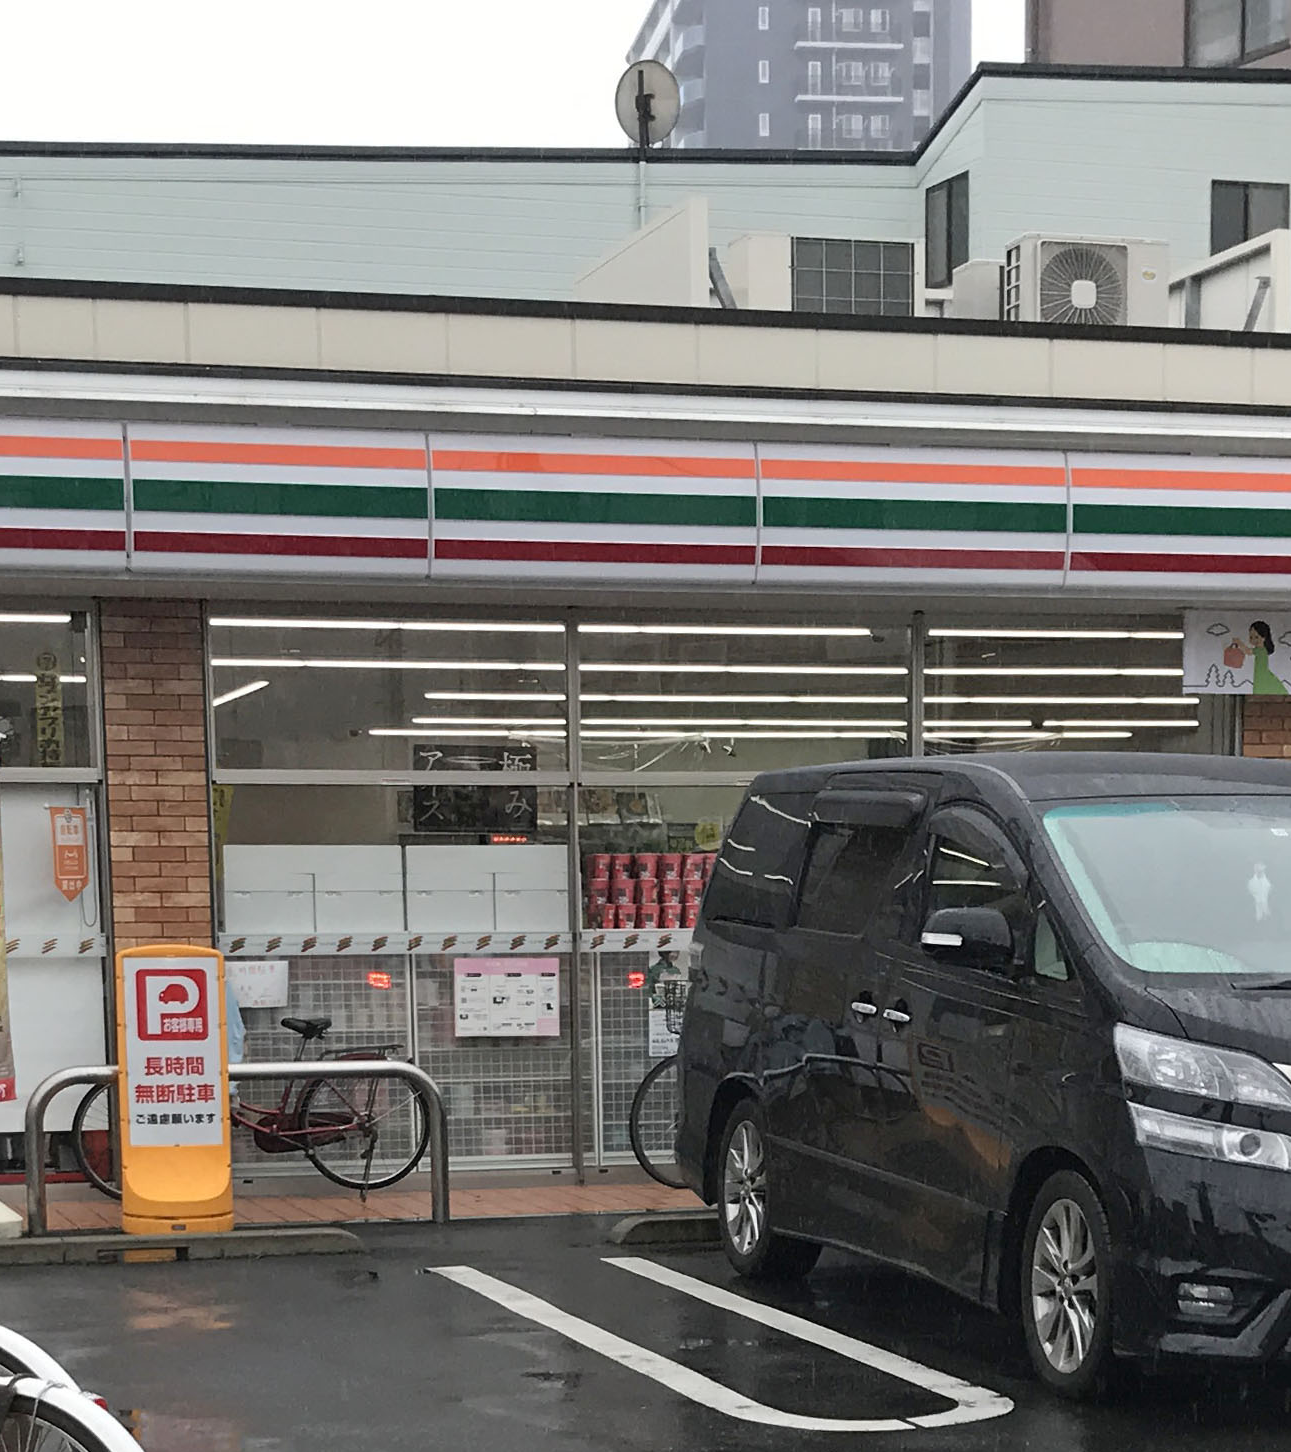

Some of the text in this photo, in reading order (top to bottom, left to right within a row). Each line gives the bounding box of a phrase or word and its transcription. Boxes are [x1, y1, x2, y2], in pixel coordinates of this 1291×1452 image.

[144, 1056, 205, 1076] 長時間
[134, 1084, 216, 1104] 無断駐車
[136, 1113, 216, 1125] ご遠慮願います
